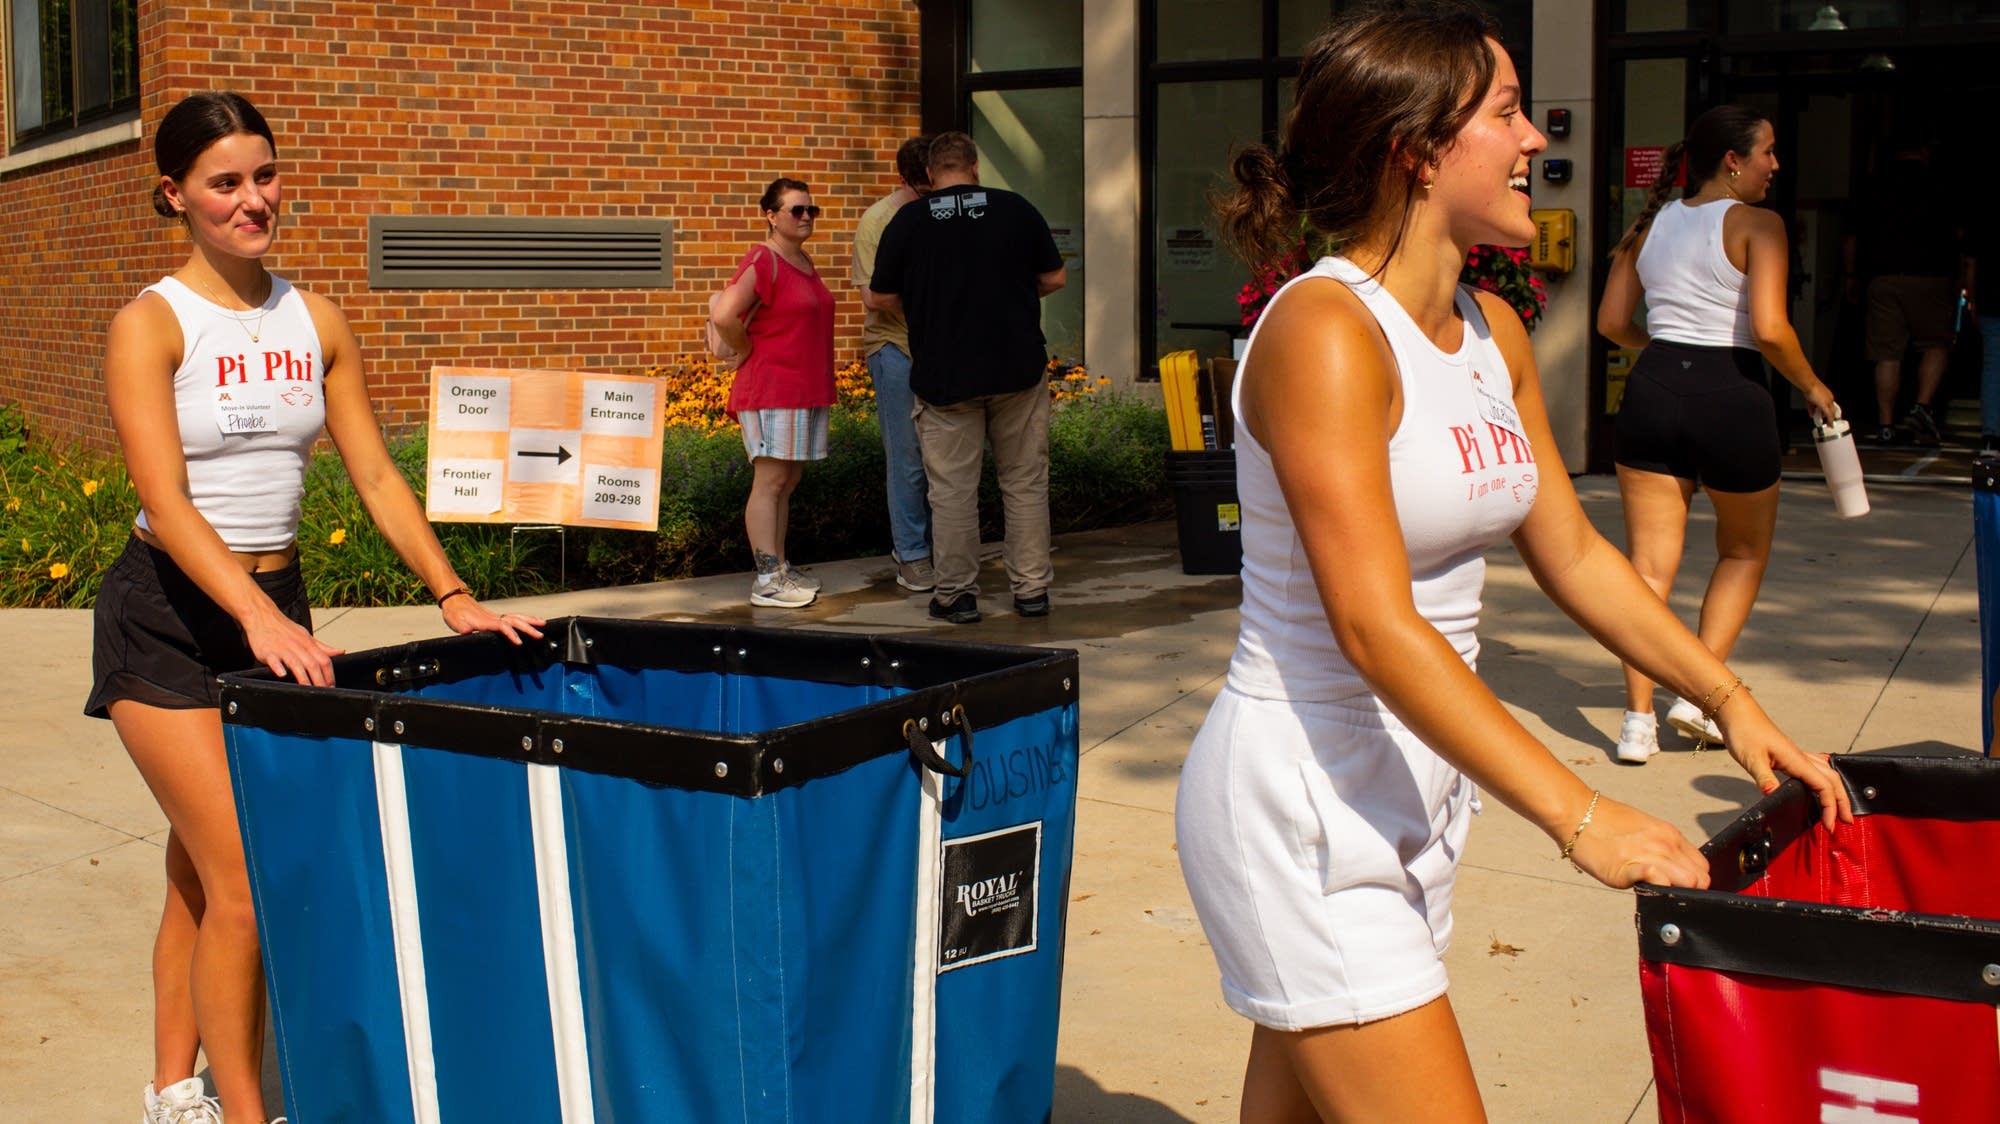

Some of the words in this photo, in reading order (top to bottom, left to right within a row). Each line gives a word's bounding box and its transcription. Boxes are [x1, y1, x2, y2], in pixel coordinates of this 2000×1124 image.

[215, 353, 248, 387] Pi
[261, 350, 313, 382] Phi
[451, 386, 497, 399] Orange
[604, 391, 633, 403] Main
[458, 404, 489, 415] Door
[590, 408, 646, 421] Entrance
[228, 413, 266, 431] Phoebe
[1448, 423, 1486, 474] Pi
[1486, 421, 1535, 465] Ph
[443, 469, 491, 480] Frontier
[598, 475, 641, 488] Rooms
[454, 486, 478, 497] Hall
[1468, 483, 1475, 501] I
[1477, 484, 1489, 498] am
[1491, 476, 1507, 492] one
[594, 492, 641, 505] 209-298
[956, 872, 1019, 917] ROYAL
[972, 896, 995, 908] BASKET
[996, 889, 1016, 900] TRUCKS
[944, 949, 957, 959] 12
